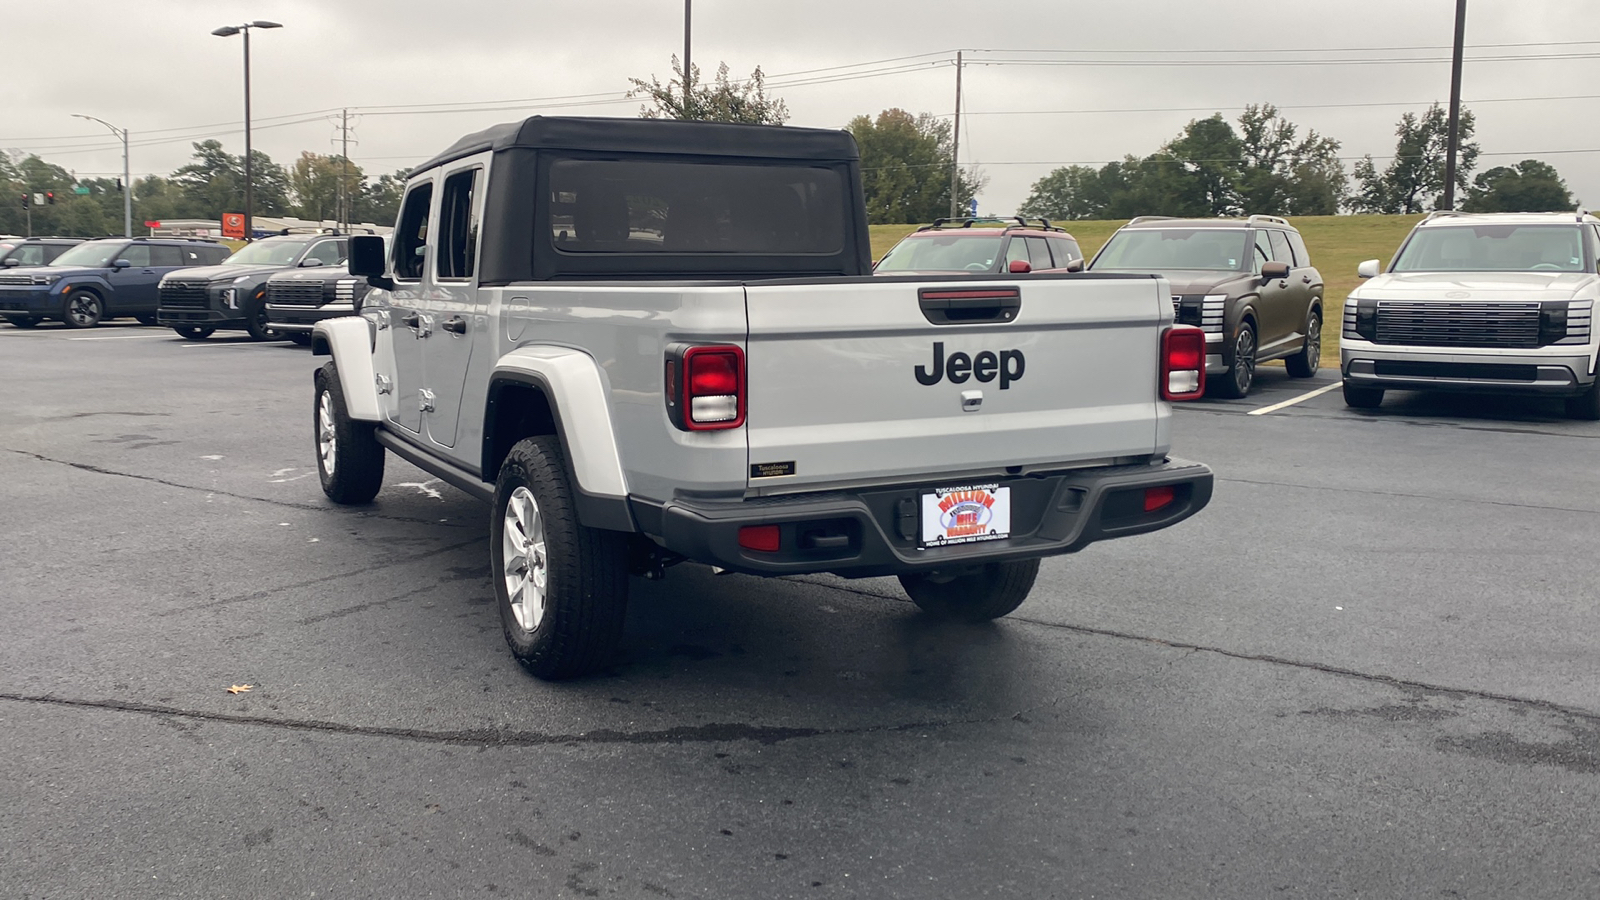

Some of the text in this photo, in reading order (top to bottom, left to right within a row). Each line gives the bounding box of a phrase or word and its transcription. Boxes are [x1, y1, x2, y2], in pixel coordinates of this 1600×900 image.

[914, 341, 1025, 390] Jeep
[935, 483, 999, 493] TUSCALOOSA HYUNDAI
[938, 490, 996, 513] MILLION
[956, 513, 978, 526] MILE
